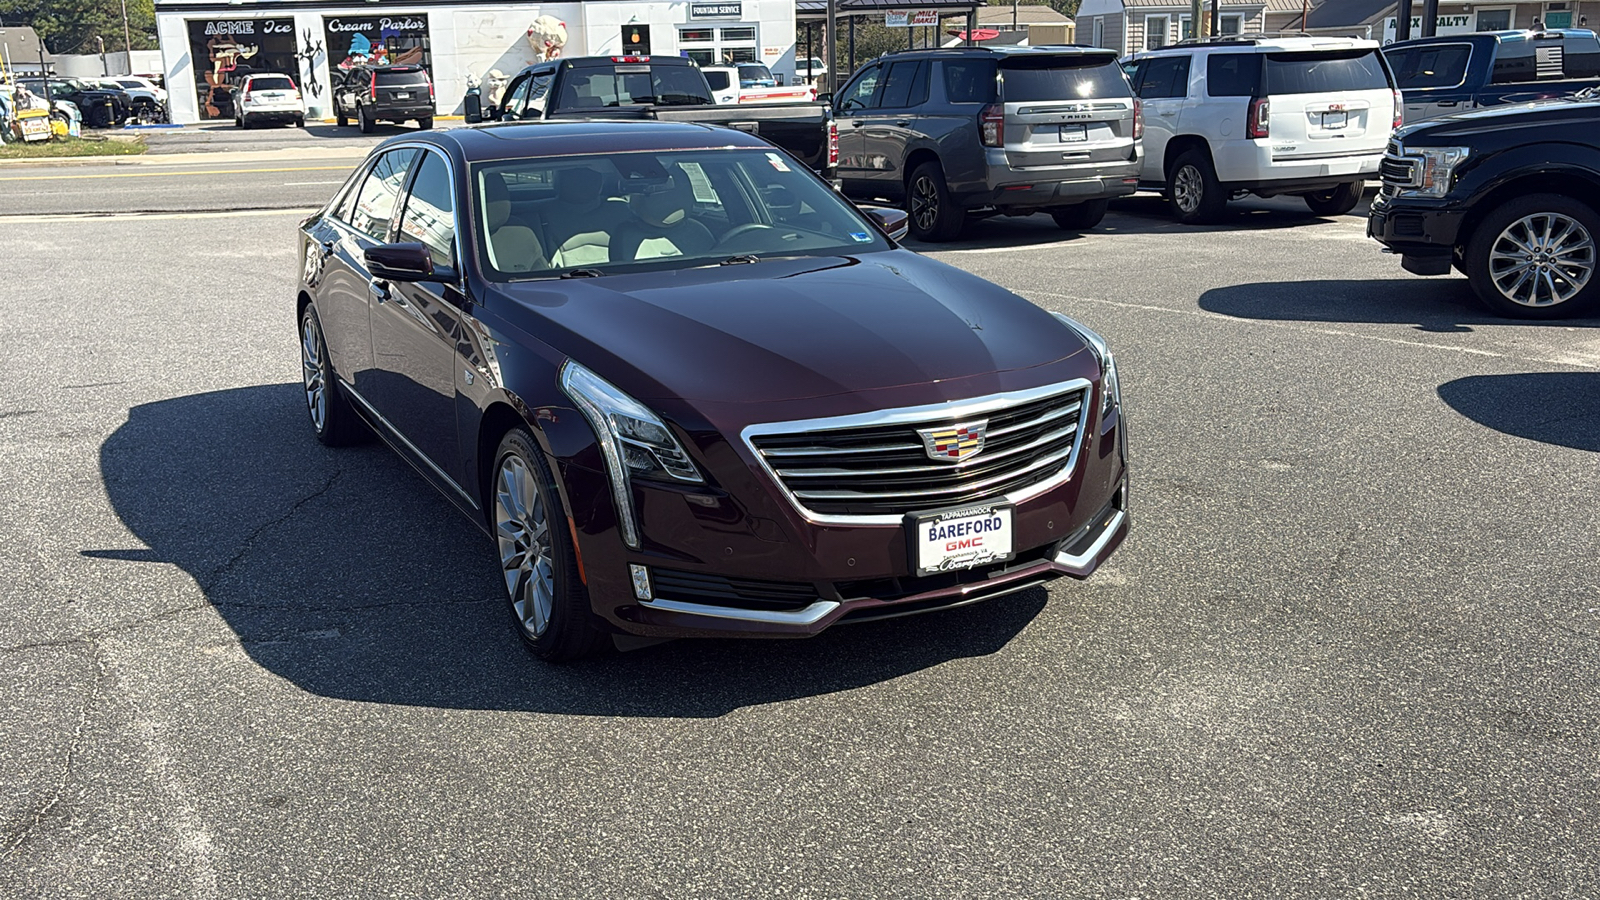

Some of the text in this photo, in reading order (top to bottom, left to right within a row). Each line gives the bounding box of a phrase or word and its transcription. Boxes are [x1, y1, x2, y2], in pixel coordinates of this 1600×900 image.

[719, 5, 740, 14] SERVICE
[204, 17, 426, 35] ACME Ice Cream Parlor
[1389, 18, 1420, 29] AX
[941, 507, 991, 520] TAPPAHANNOCK
[929, 517, 1002, 542] BAREFORD
[946, 537, 983, 552] GMC
[940, 552, 994, 571] Bareford
